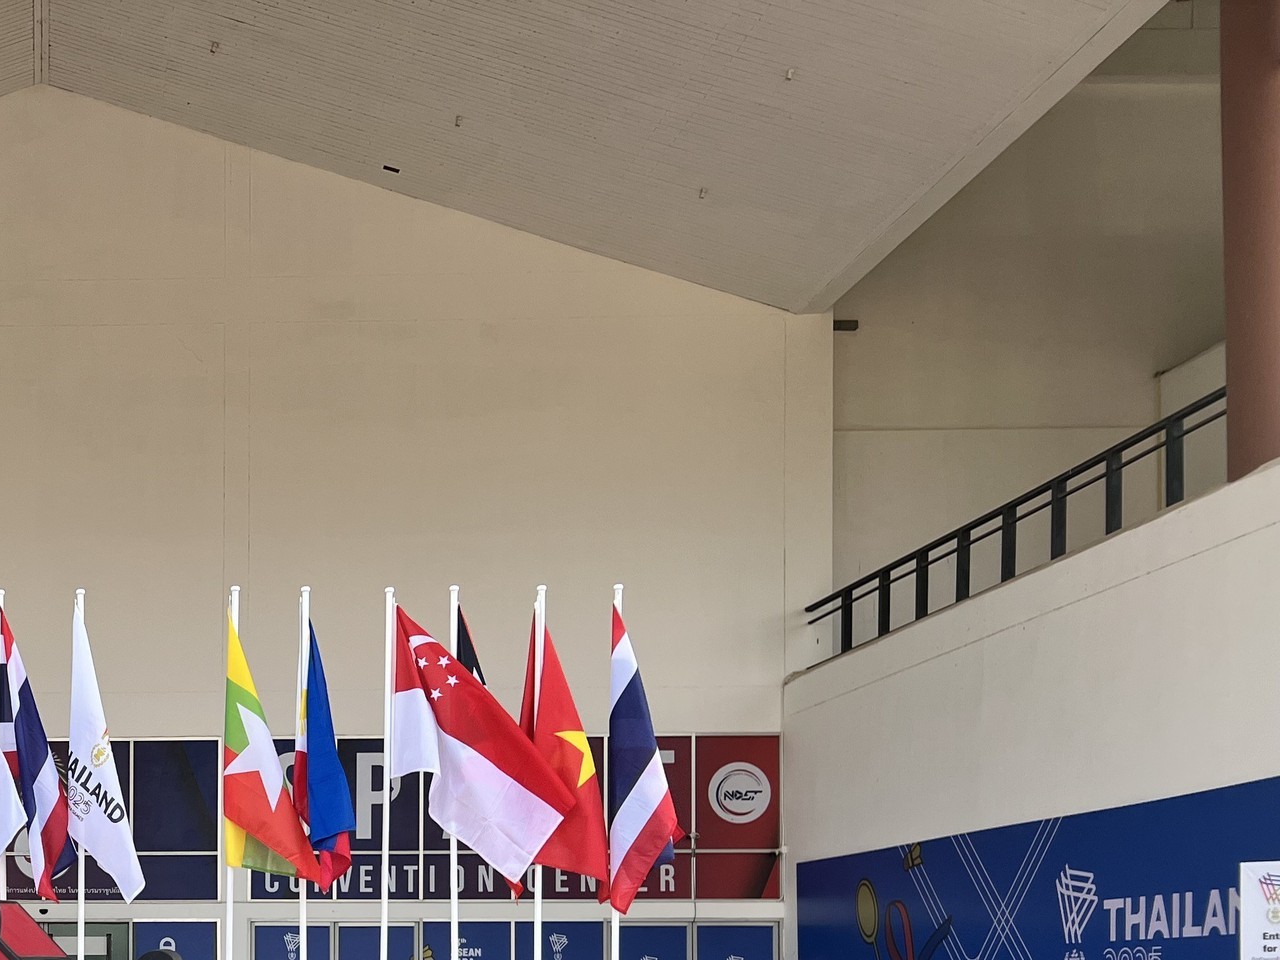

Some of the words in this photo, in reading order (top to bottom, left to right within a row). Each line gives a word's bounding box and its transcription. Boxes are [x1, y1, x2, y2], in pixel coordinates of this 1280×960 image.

[68, 750, 125, 824] AILAND
[68, 785, 94, 815] 025
[1103, 886, 1241, 942] THAILAN
[452, 948, 481, 957] SEAN
